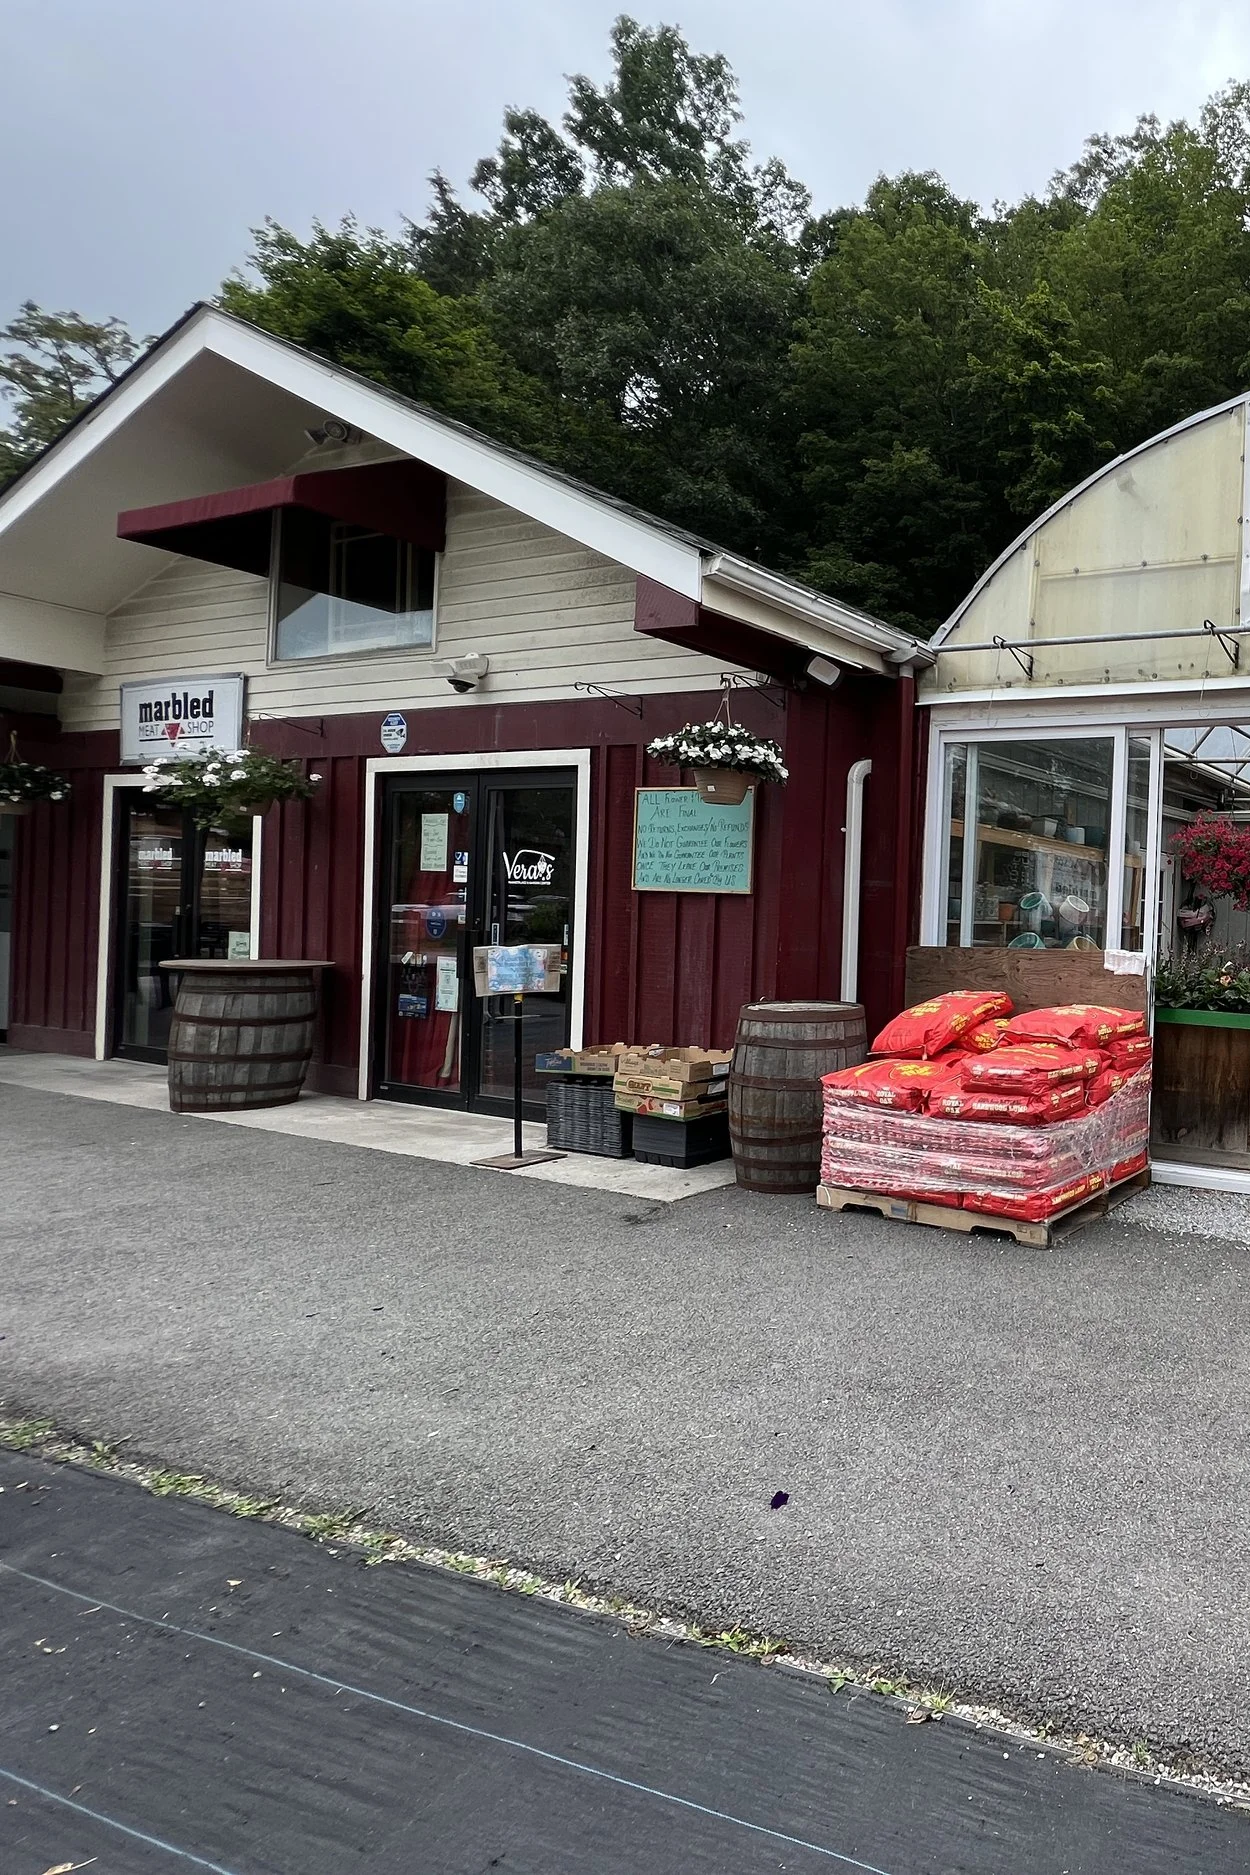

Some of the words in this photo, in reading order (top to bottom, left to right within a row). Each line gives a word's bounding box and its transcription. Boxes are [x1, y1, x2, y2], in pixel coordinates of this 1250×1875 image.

[139, 690, 215, 723] marbled
[138, 724, 160, 737] MEAT
[187, 720, 214, 734] SHOP
[204, 848, 242, 862] marbled
[942, 1099, 964, 1107] ROYAL
